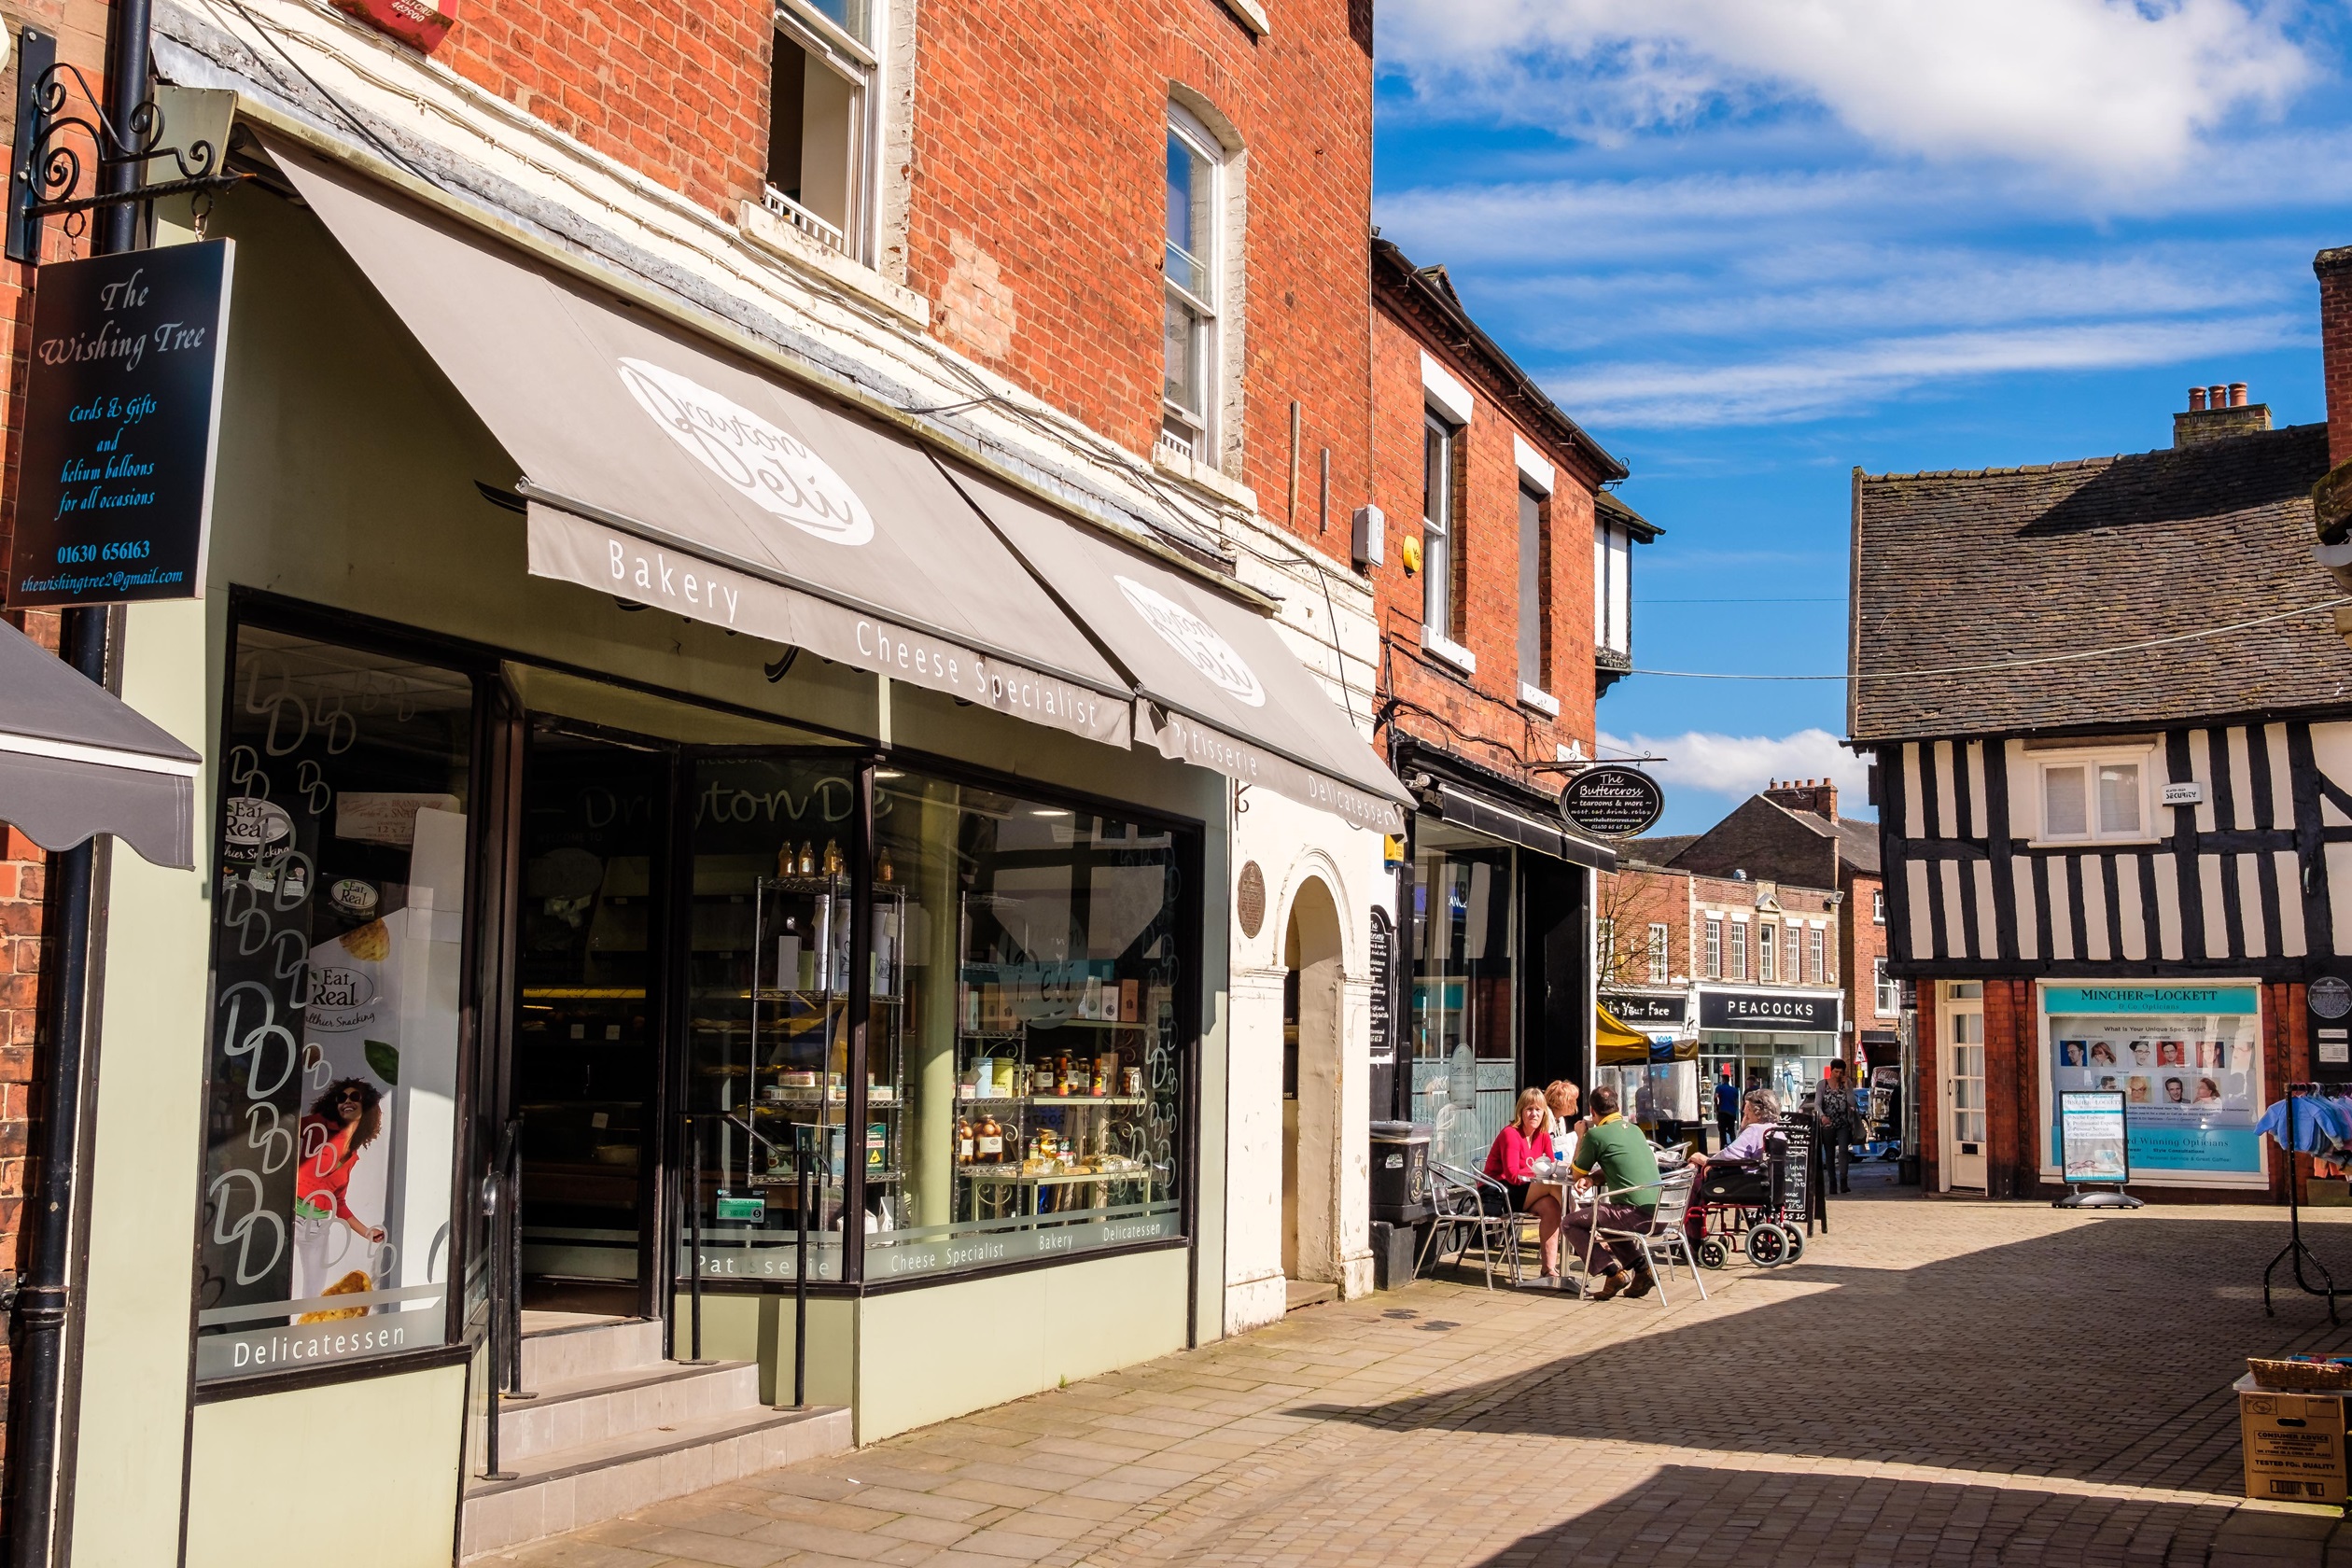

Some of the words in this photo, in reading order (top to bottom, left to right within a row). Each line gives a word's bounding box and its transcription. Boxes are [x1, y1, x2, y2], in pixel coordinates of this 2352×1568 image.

[391, 1, 426, 22] 462900
[101, 268, 149, 311] The
[38, 320, 147, 371] Wishing
[154, 321, 205, 352] Tree
[69, 397, 103, 422] Cards
[107, 398, 122, 418] &
[124, 394, 157, 424] Gifts
[97, 427, 123, 452] and
[61, 458, 100, 483] helium
[105, 454, 154, 479] balloons
[54, 491, 77, 521] for
[80, 486, 102, 509] all
[100, 487, 155, 508] occasions
[57, 544, 97, 564] 01630
[102, 540, 150, 560] 656163
[21, 567, 183, 594] thewishingtree2@gmail.com
[609, 538, 739, 624] Bakery
[856, 620, 959, 683] Cheese
[975, 662, 1097, 728] Specialist
[1600, 773, 1625, 784] The
[1308, 774, 1398, 827] Delicatessen
[1579, 785, 1645, 797] Buttercross
[2165, 791, 2197, 800] SECURITY
[235, 802, 264, 819] Eat
[340, 889, 368, 906] Real
[348, 881, 365, 893] Eat
[323, 969, 350, 986] Eat
[311, 982, 357, 1006] Real
[2080, 989, 2144, 1001] MINCHER
[2154, 990, 2218, 1001] LOCKETT
[1648, 1001, 1671, 1016] Face
[1728, 1001, 1814, 1016] PEACOCKS
[2142, 1002, 2180, 1012] Opticians
[336, 1012, 375, 1028] Snacking
[2140, 1138, 2179, 1148] Winning
[2182, 1138, 2229, 1148] Opticians
[891, 1253, 936, 1273] Cheese
[946, 1243, 1005, 1267] Specialist
[1039, 1235, 1074, 1251] Bakery
[1103, 1223, 1162, 1242] Delicatessen
[233, 1324, 405, 1368] Delicatessen
[2300, 1434, 2330, 1442] ADVICE
